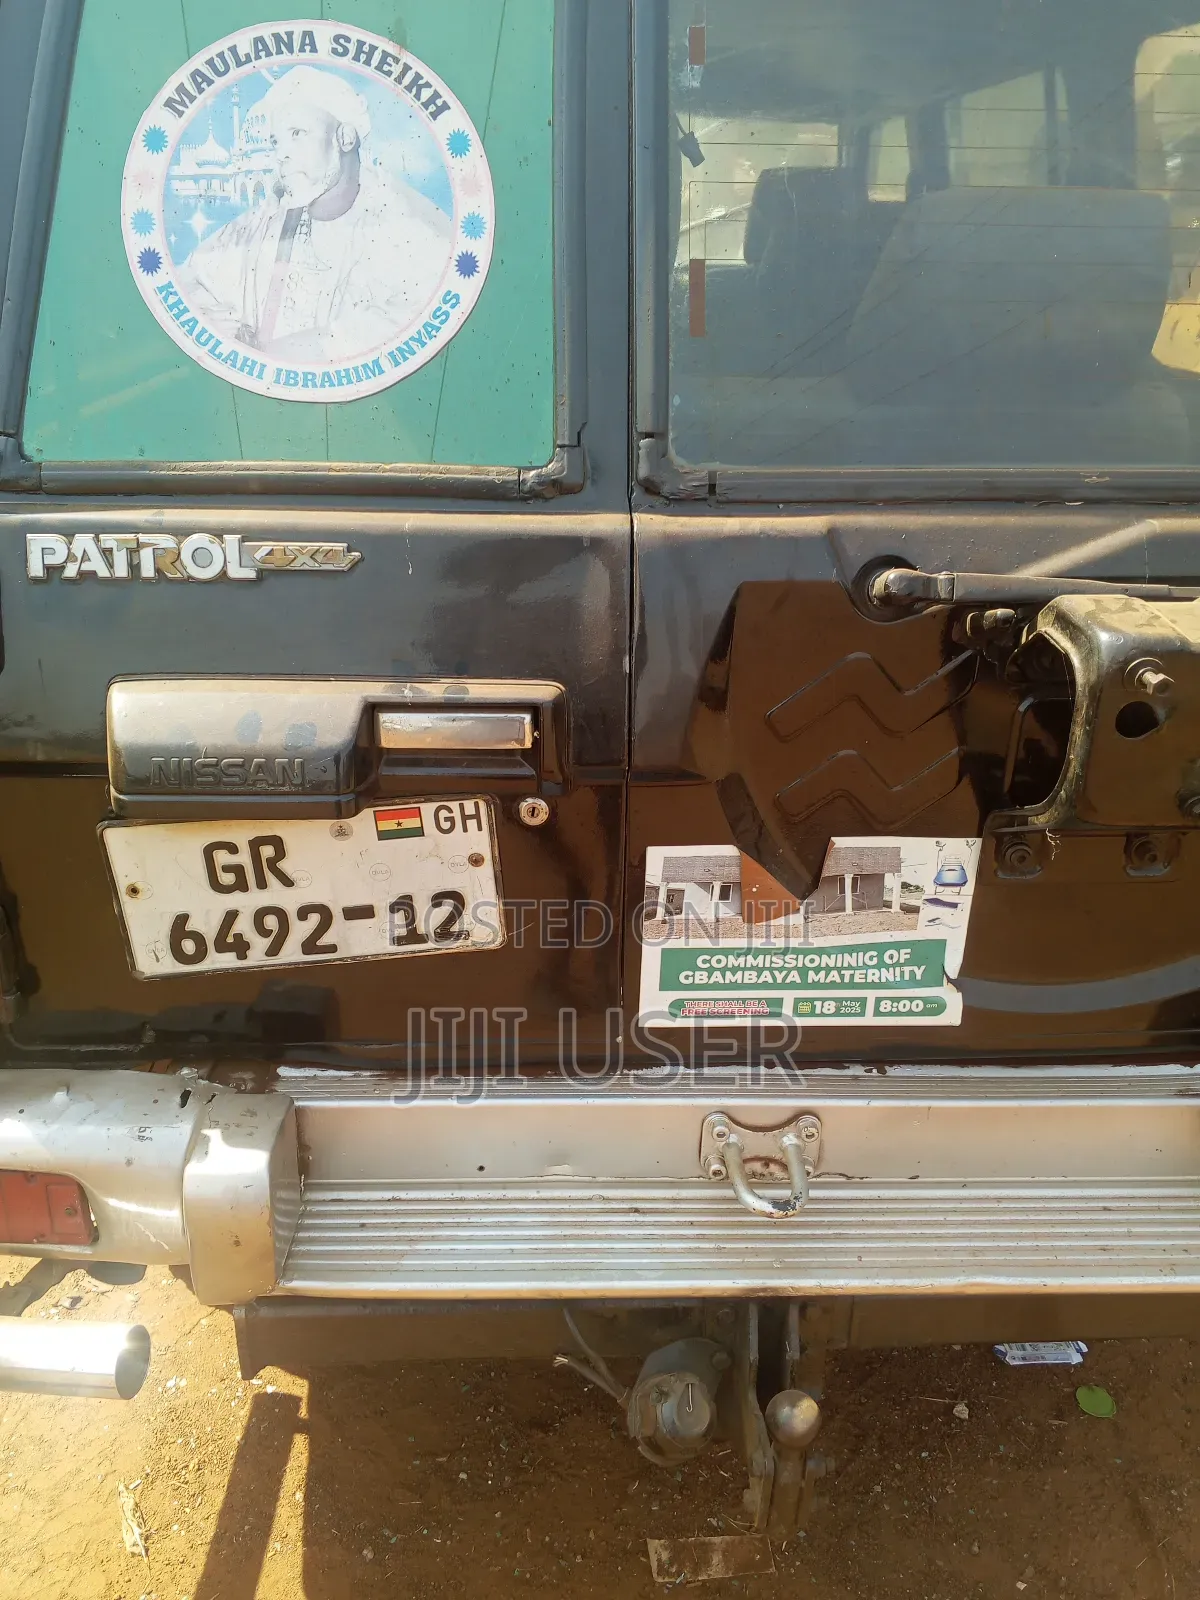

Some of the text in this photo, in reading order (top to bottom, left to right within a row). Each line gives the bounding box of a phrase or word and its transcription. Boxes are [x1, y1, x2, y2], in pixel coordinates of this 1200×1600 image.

[161, 30, 452, 122] MAULANA SHEIKH
[155, 280, 461, 389] KHAULAHI IBRAHIM INYASS
[26, 533, 260, 581] PATROL
[150, 757, 307, 787] NISSAN
[433, 801, 483, 834] GH
[203, 835, 295, 895] GR
[169, 890, 470, 965] 6492-12
[696, 948, 912, 969] COMMISSIONINIG OF
[678, 965, 926, 985] GBAMBAYA MATERNITY
[681, 1007, 769, 1016] FREE SCREENING
[684, 1000, 767, 1008] THERE SHALL BE A
[842, 1000, 861, 1008] May
[879, 999, 924, 1013] 8:00
